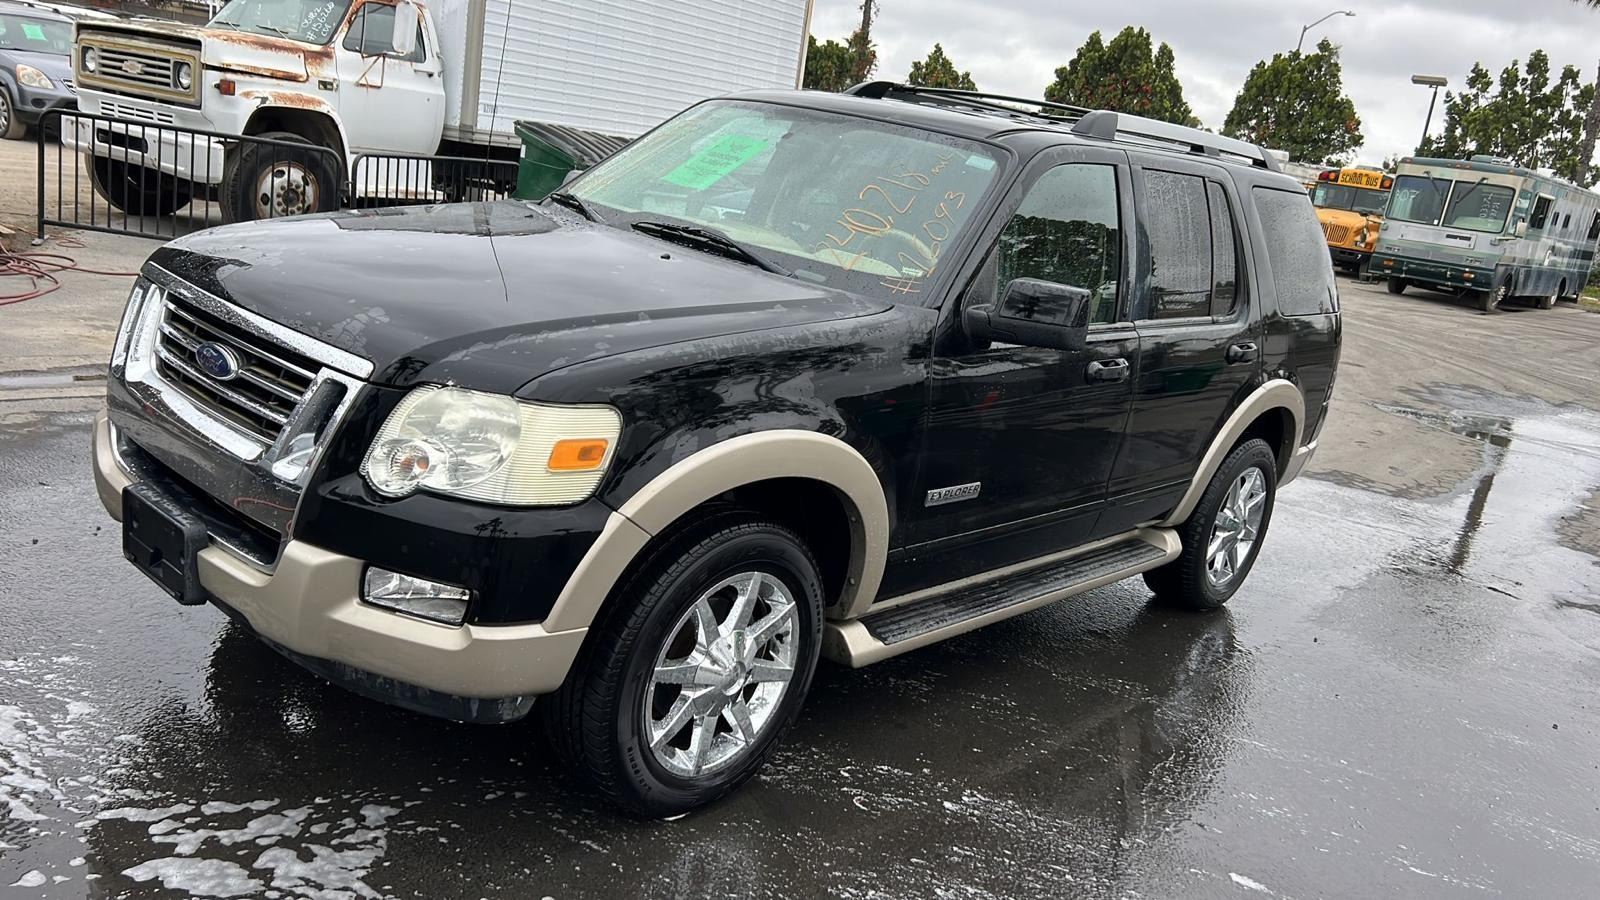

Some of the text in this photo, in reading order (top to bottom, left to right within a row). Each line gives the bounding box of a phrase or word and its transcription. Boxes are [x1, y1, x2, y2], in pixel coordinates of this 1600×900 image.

[1340, 172, 1379, 187] SCHOOL BUS
[929, 484, 980, 501] EXPLORER
